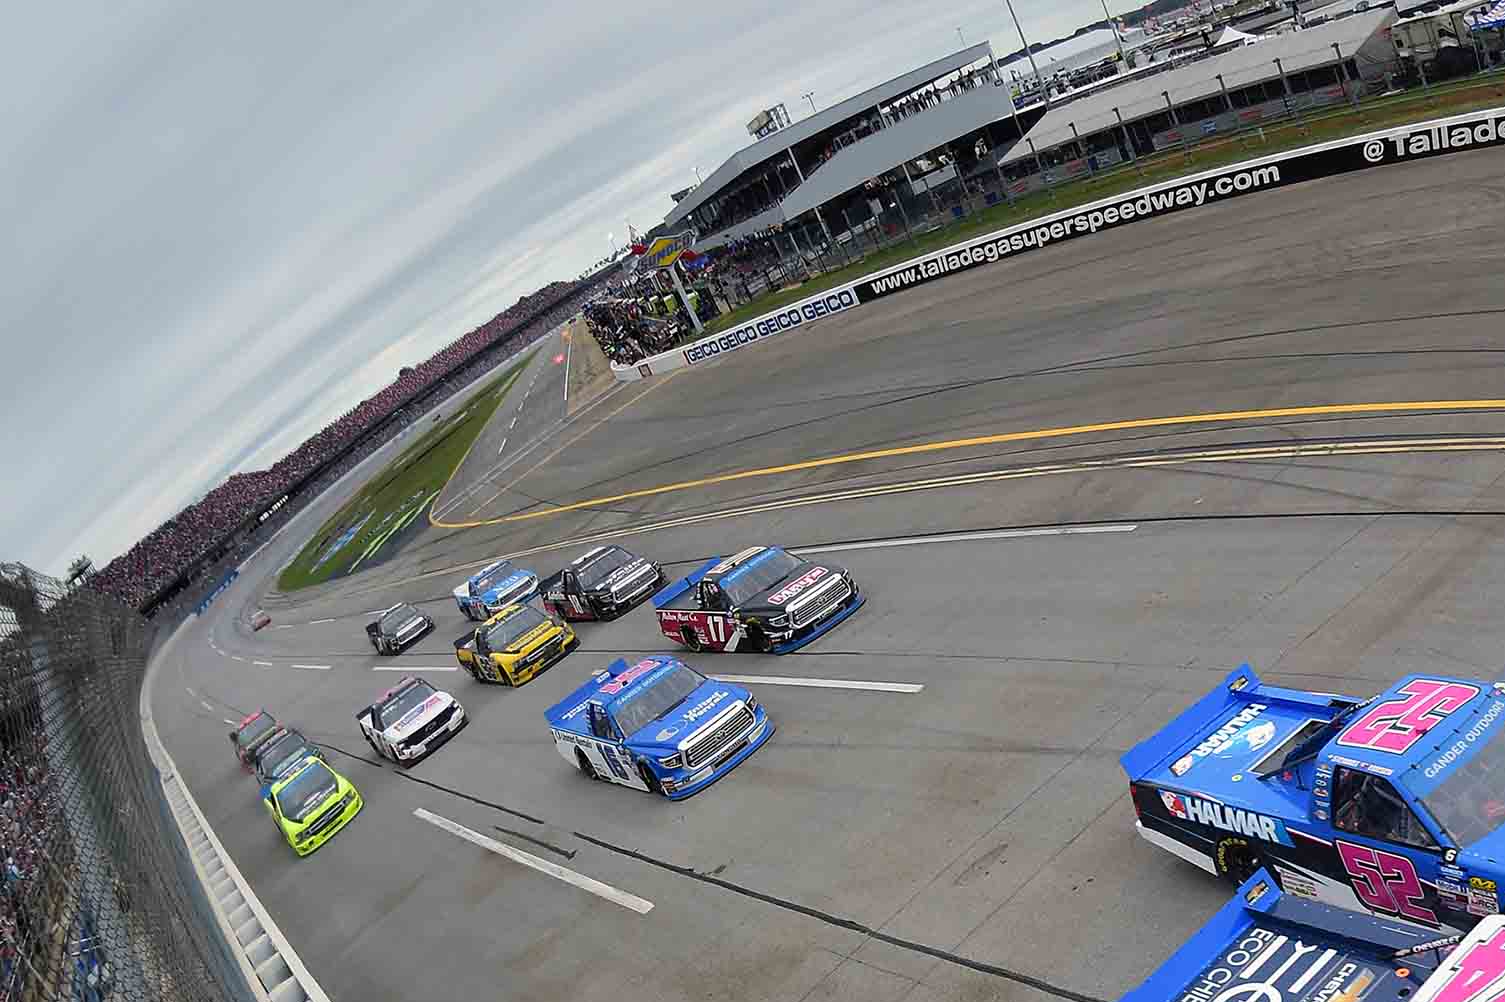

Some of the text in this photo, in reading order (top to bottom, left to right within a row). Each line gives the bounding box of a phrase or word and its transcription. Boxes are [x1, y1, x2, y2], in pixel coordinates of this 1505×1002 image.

[871, 163, 1280, 295] www.talladegasuperspeedway.com
[687, 290, 855, 363] GEICO GEICO GEICO GEICO
[706, 615, 725, 643] 17
[1193, 703, 1267, 758] HALMAR
[1336, 679, 1481, 755] 52
[1424, 743, 1467, 779] GANDER
[1465, 700, 1505, 745] OUTDOORS
[1185, 798, 1278, 844] HALMAR
[1334, 839, 1441, 927] 52
[1227, 927, 1273, 966] ECO
